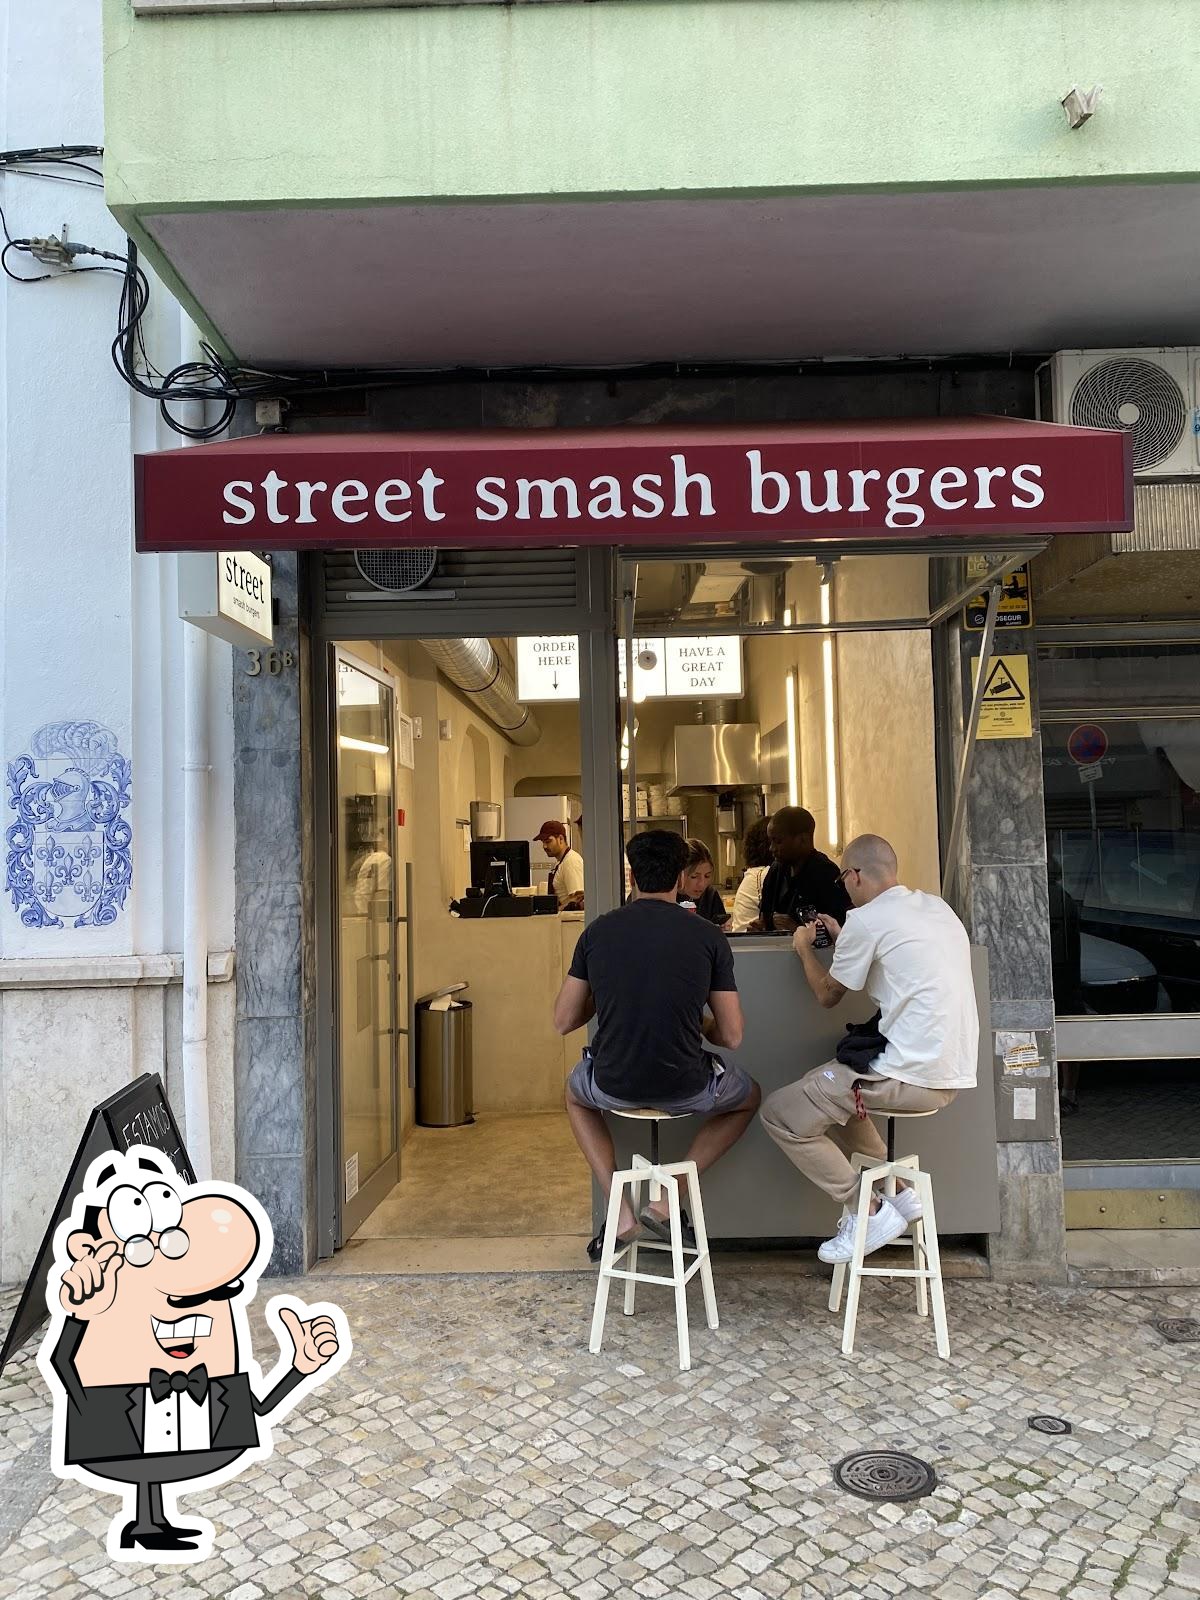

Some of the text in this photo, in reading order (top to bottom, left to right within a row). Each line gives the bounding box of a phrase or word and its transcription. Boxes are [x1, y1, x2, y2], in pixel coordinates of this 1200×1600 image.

[222, 449, 1046, 529] street smash burgers
[226, 555, 265, 604] street
[533, 641, 576, 652] ORDER
[679, 646, 726, 657] HAVE A
[538, 655, 572, 666] HERE
[681, 661, 724, 672] GREAT
[690, 676, 716, 687] DAY
